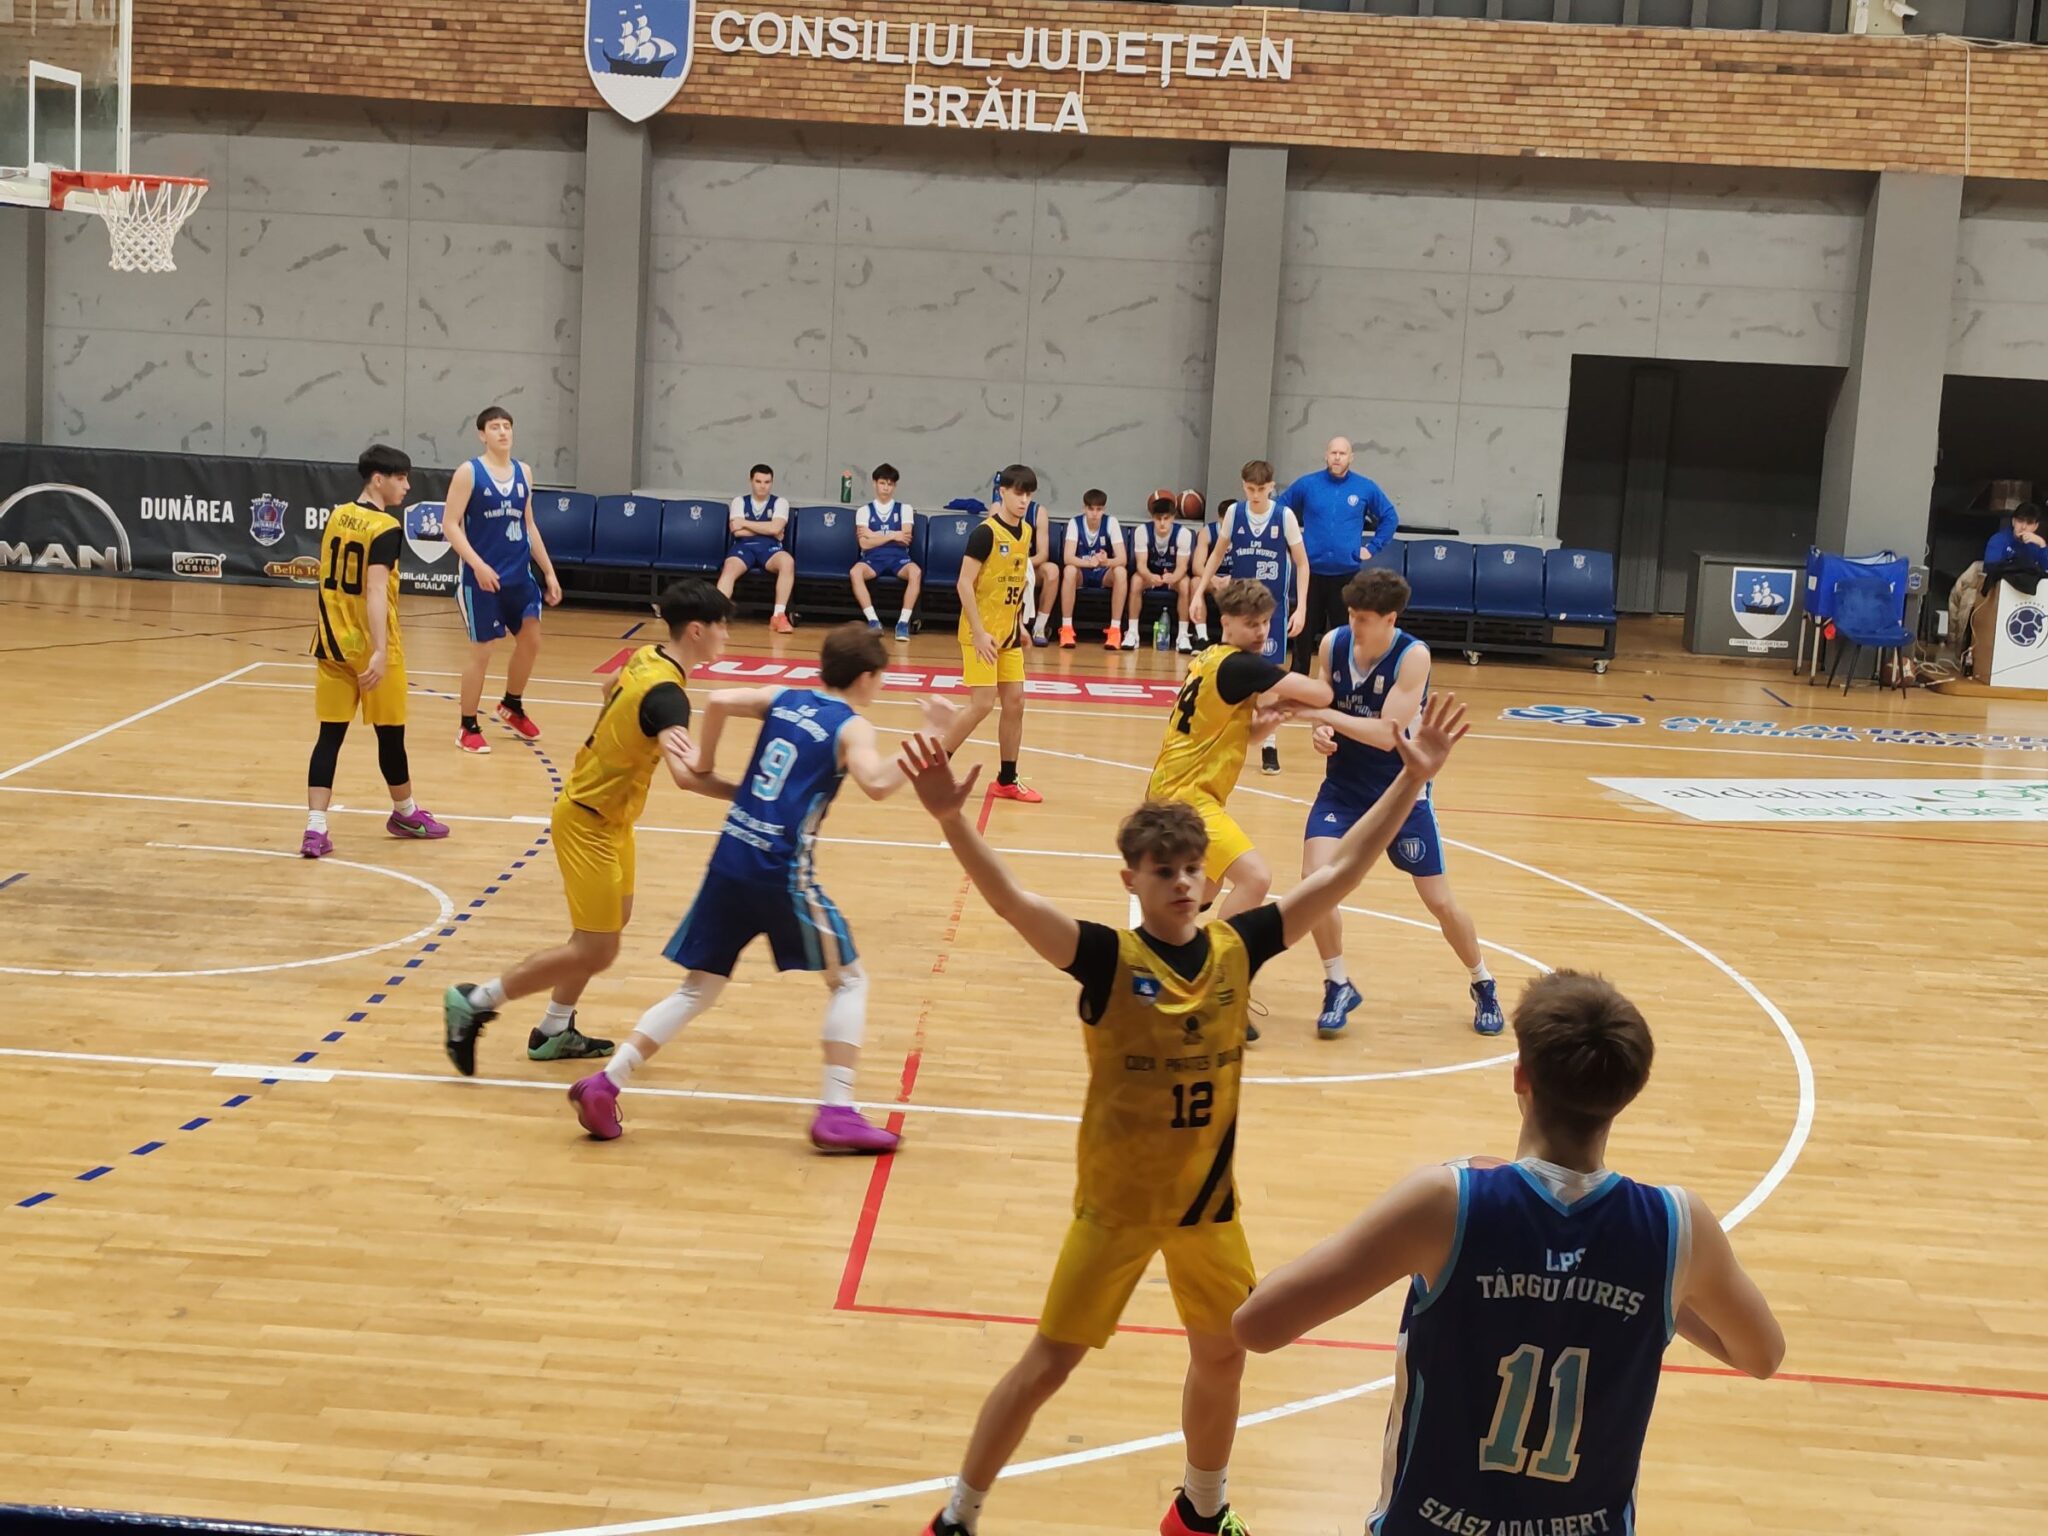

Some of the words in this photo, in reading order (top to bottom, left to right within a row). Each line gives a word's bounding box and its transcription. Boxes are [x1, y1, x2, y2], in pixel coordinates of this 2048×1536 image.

[710, 9, 992, 67] CONSILIUL
[1006, 26, 1294, 89] JUDEȚEAN
[903, 75, 1089, 134] BRĂILA
[140, 494, 235, 523] DUNĂREA
[0, 540, 118, 572] MAN
[176, 556, 218, 566] PLOTTER
[176, 565, 219, 573] DESIGN
[273, 564, 303, 576] Bella
[323, 535, 365, 596] 10
[1255, 561, 1279, 580] 23
[1005, 586, 1020, 605] 35
[1661, 715, 1778, 729] ALB
[751, 737, 798, 801] 9
[1663, 786, 1896, 799] aldahra
[1170, 1080, 1214, 1129] 12
[1476, 1267, 1561, 1302] TÂRGU
[1478, 1342, 1591, 1483] 11
[1418, 1497, 1492, 1536] SZÁSZ
